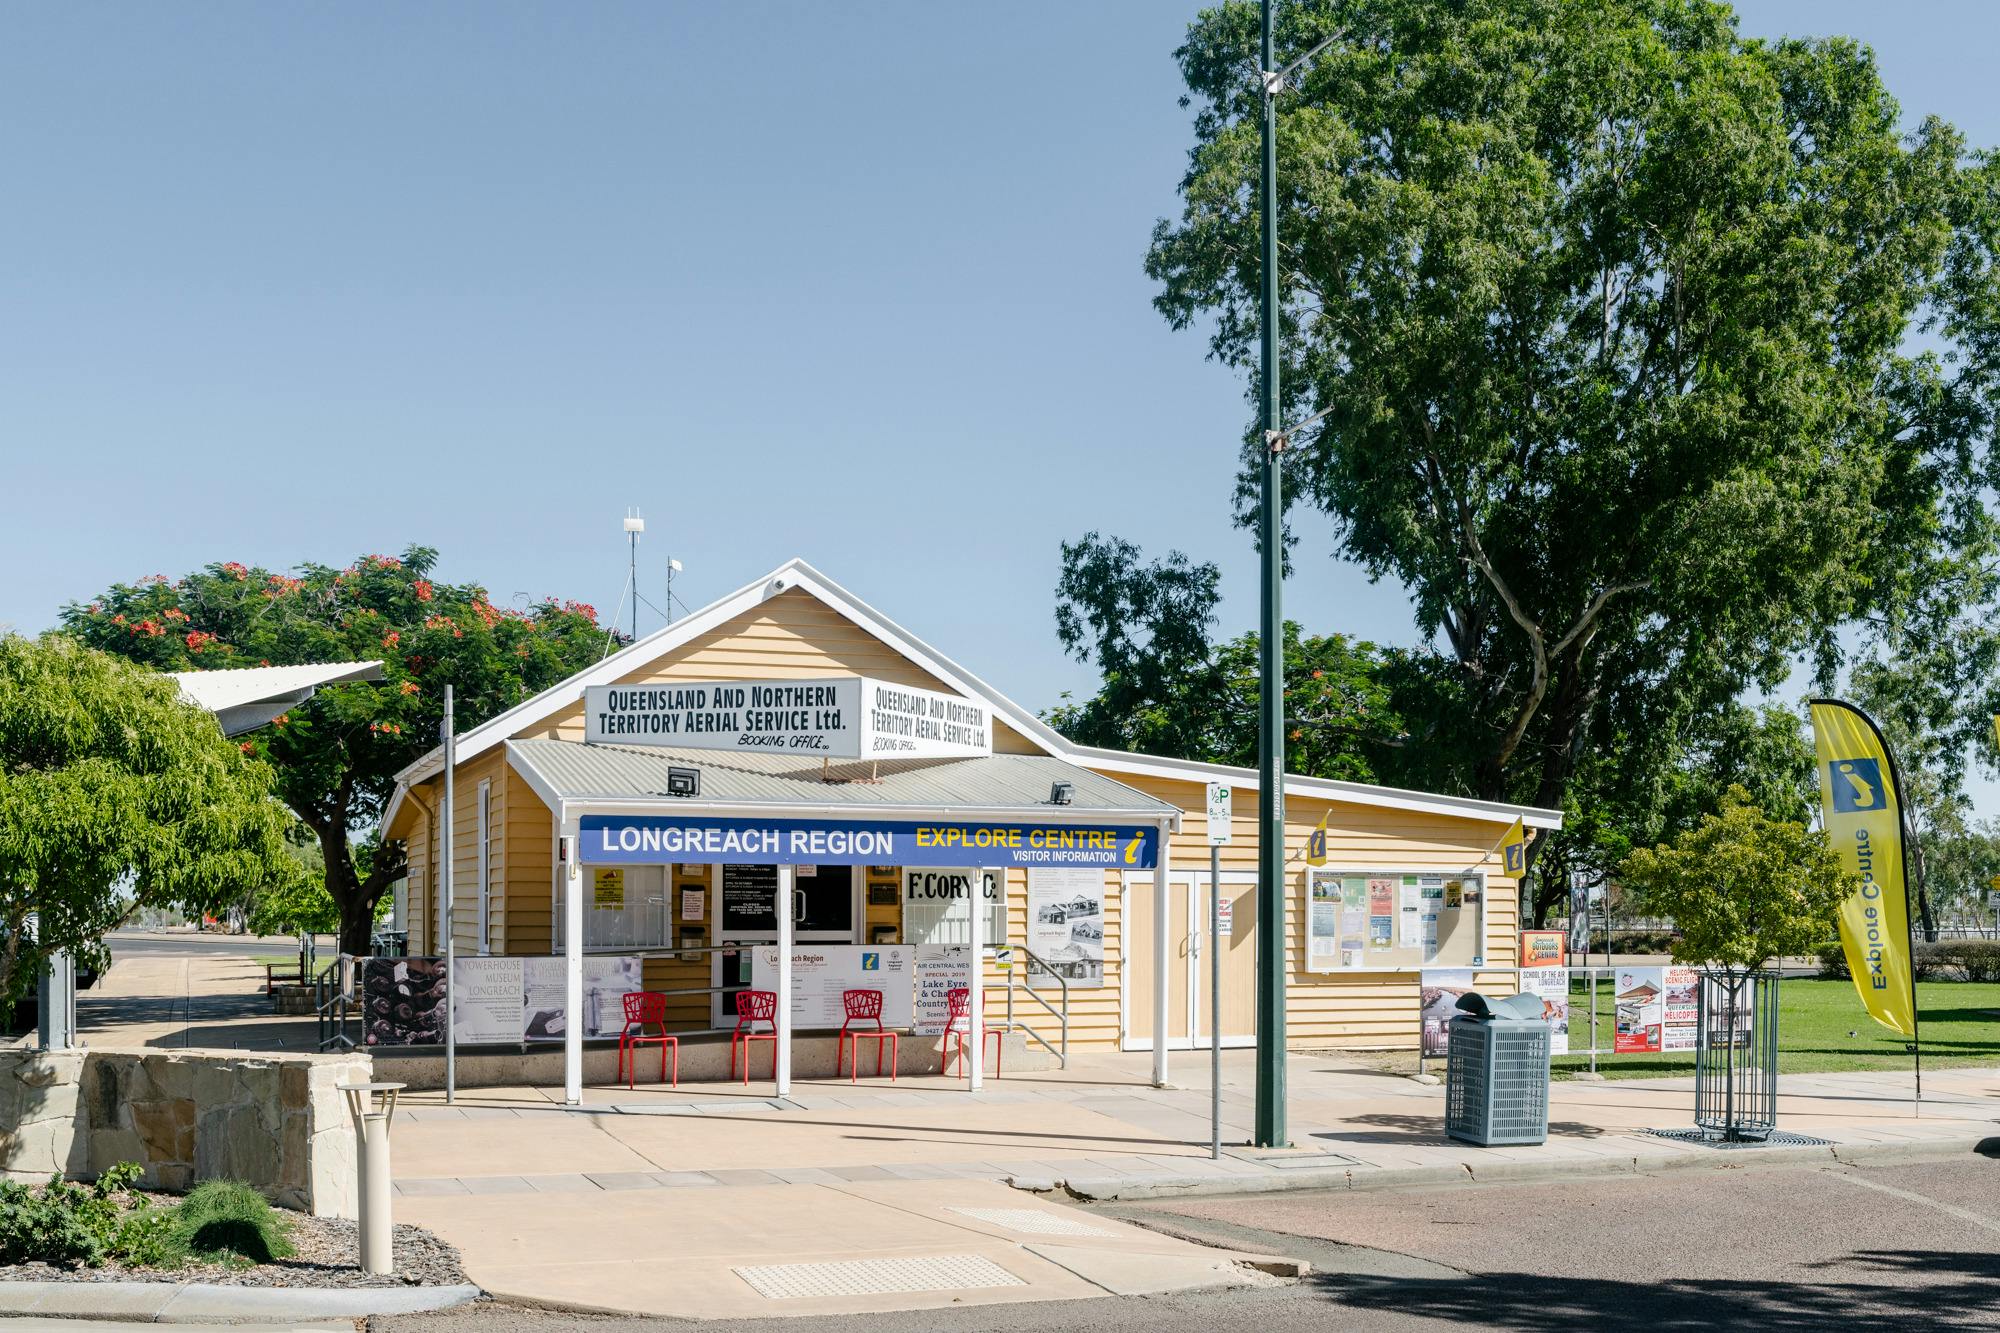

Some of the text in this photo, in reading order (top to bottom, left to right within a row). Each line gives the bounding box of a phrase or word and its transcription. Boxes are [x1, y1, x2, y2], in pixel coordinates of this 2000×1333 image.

[608, 686, 836, 713] QUEENSLAND AND NORTHERN
[876, 686, 983, 726] QUEENSLAND AND NORTHERN
[599, 709, 847, 734] TERRITORY AERIAL SERVICE Ltd.
[871, 708, 987, 748] TERRITORY AERIAL SERVICE Ltd.
[737, 733, 785, 748] BOOKING
[872, 736, 897, 751] BOOKING
[602, 827, 893, 855] LONGREACH REGION
[916, 828, 1022, 848] EXPLORE
[1029, 829, 1117, 850] CENTRE
[1013, 850, 1117, 863] VISITOR INFORMATION
[803, 954, 824, 963] Region
[1537, 950, 1559, 959] CENTRE
[464, 960, 521, 971] POWERHOUSE
[486, 973, 521, 983] MUSEUM
[1523, 970, 1566, 979] SCHOOL OF THE AIR
[1664, 976, 1698, 984] SCENIC FLIGH
[923, 980, 968, 990] Lake Eyre
[1538, 978, 1566, 986] LONGREACH
[469, 985, 521, 996] LONGREACH
[921, 990, 929, 998] &
[917, 1000, 949, 1010] Country
[1664, 1010, 1698, 1020] HELICOPTE
